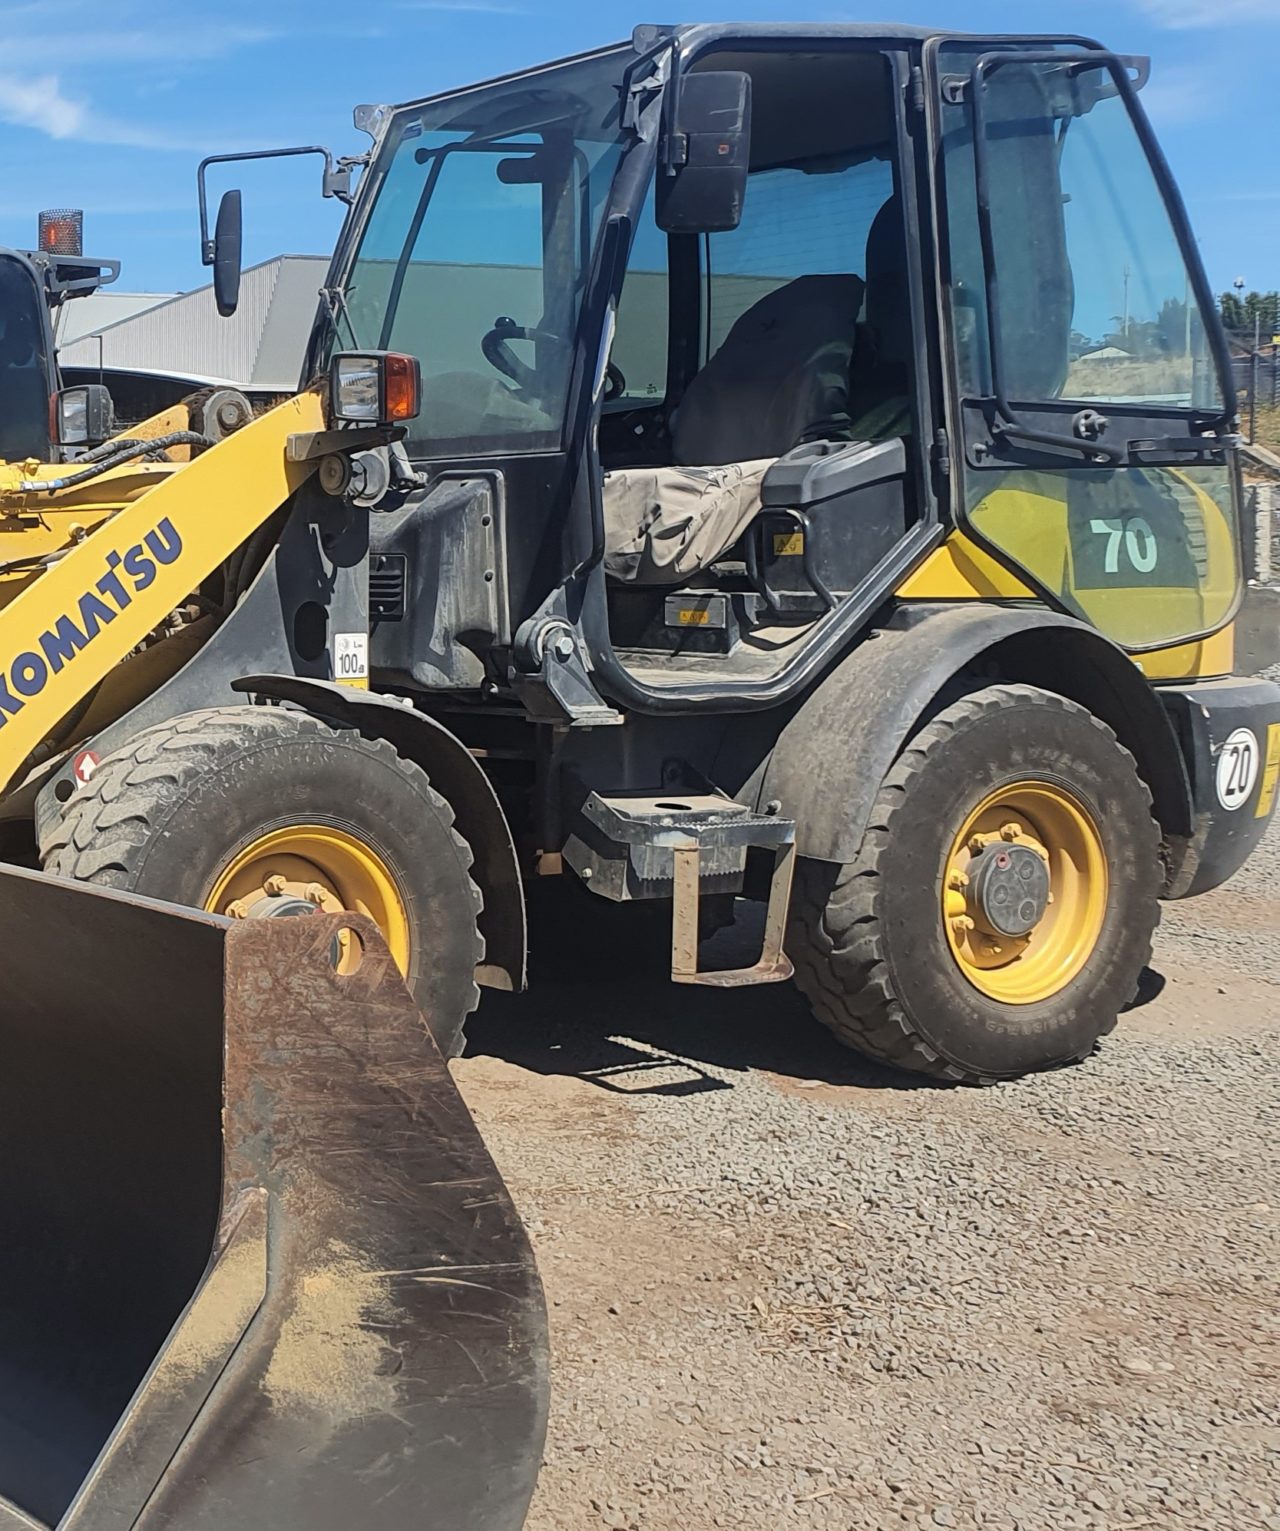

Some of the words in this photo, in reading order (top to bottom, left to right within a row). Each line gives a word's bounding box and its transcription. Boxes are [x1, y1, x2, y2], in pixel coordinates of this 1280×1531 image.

[1089, 517, 1158, 573] 70
[338, 652, 358, 675] 100
[1225, 743, 1252, 797] 20
